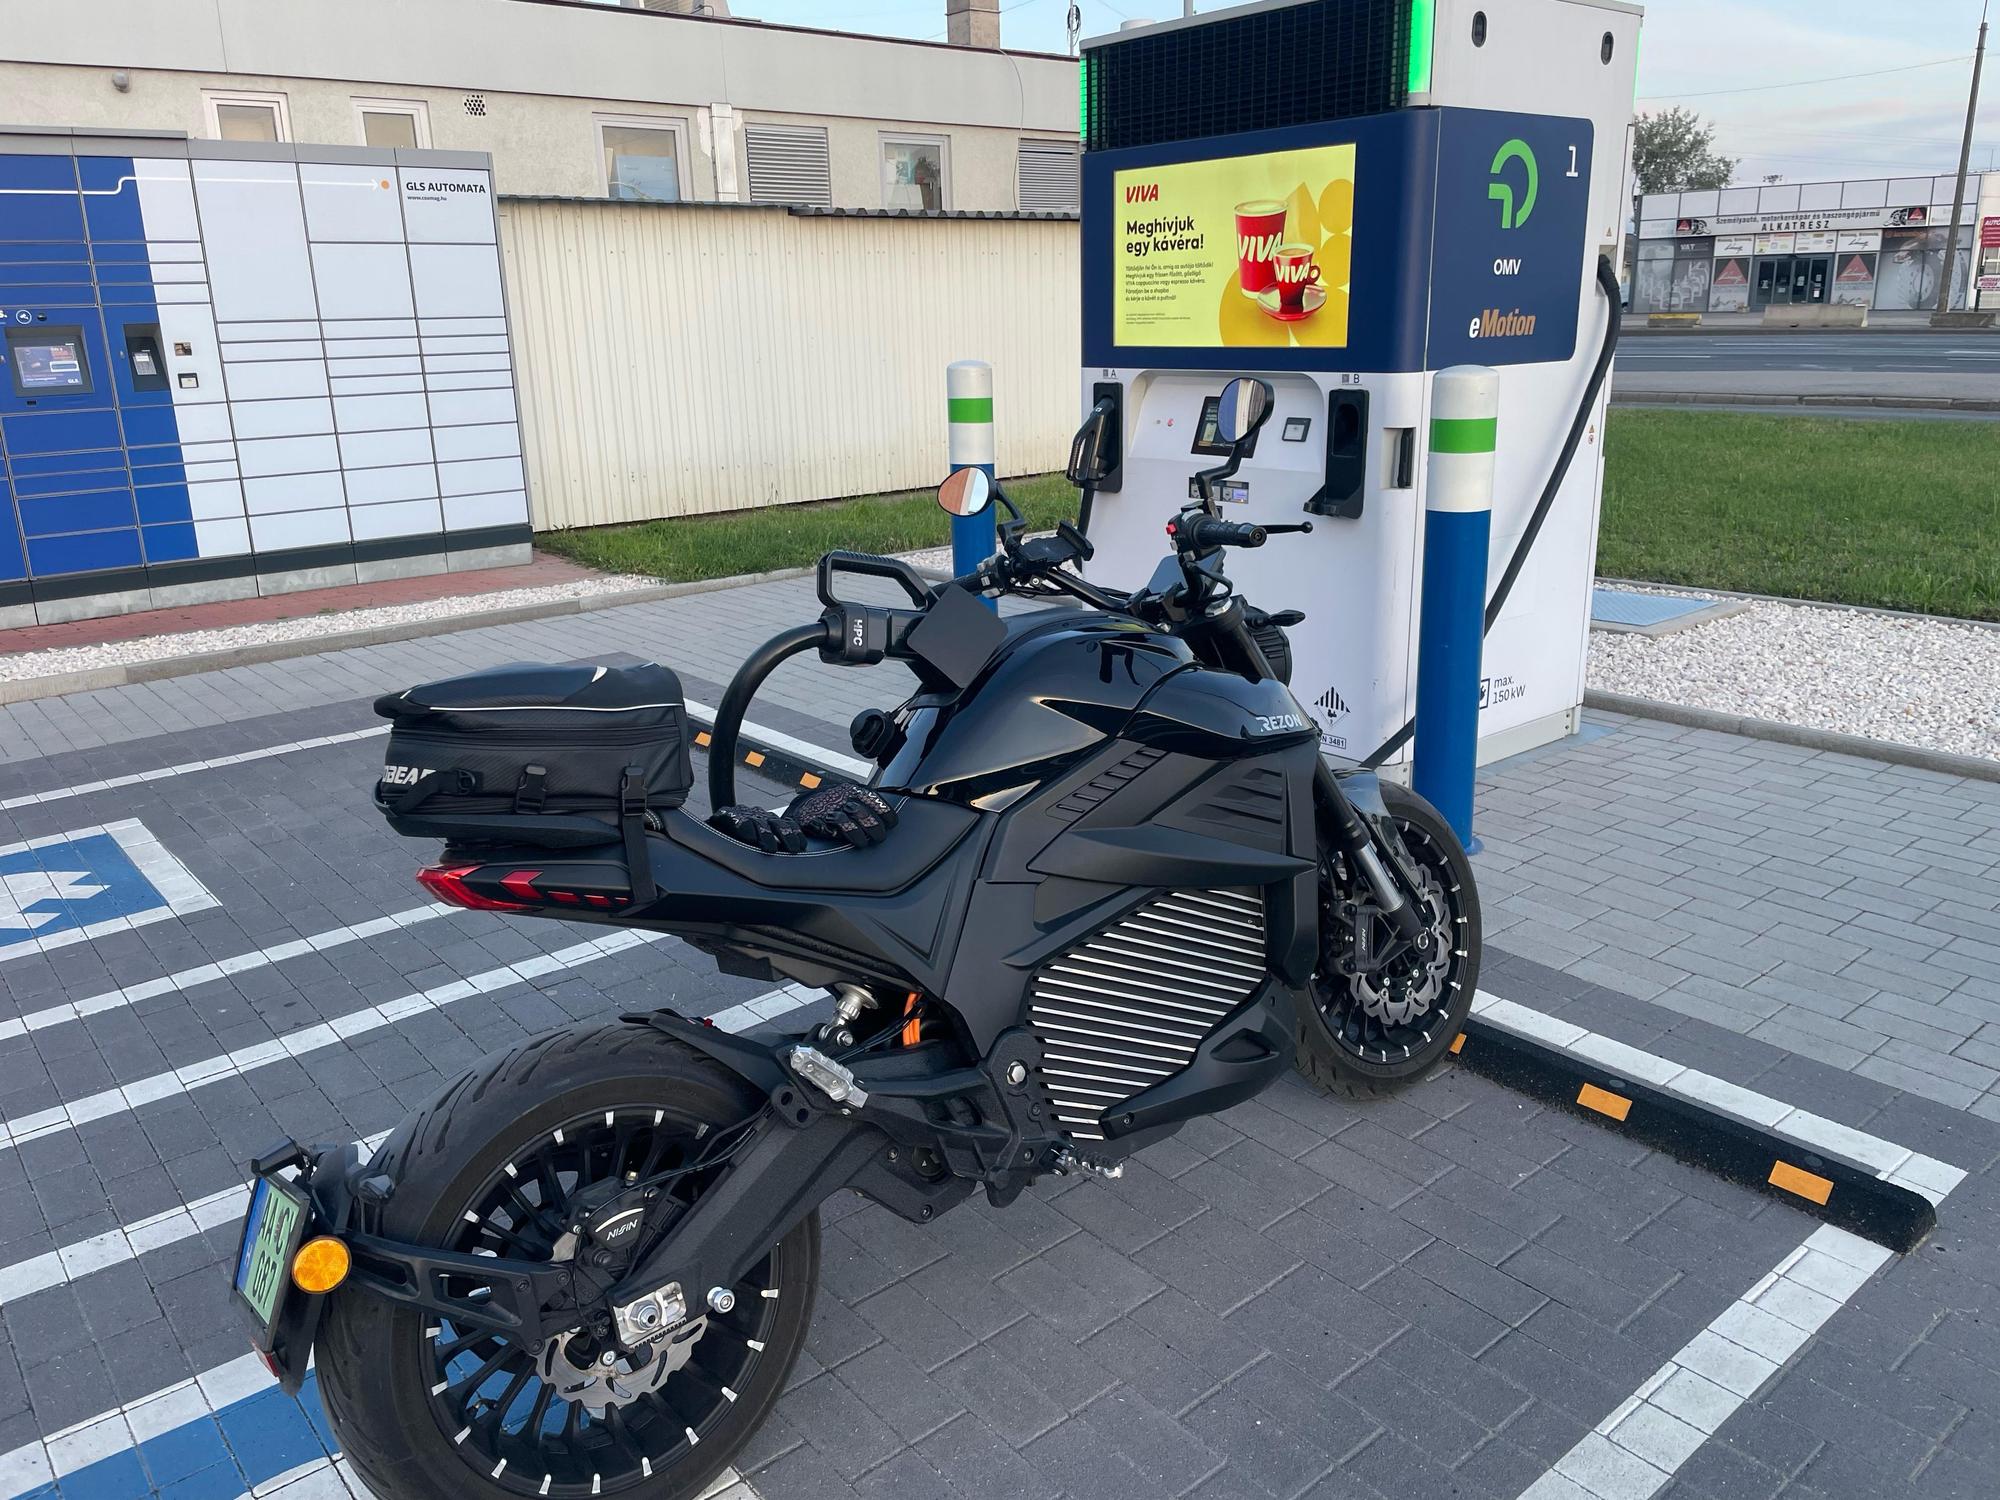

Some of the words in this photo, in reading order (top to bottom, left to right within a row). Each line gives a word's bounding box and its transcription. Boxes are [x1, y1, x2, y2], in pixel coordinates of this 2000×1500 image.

[1565, 145, 1579, 178] 1
[406, 181, 426, 192] GLS
[427, 182, 487, 194] AUTOMATA
[1125, 183, 1159, 204] VIVA
[1126, 215, 1195, 238] Meghívjuk
[1126, 241, 1151, 257] egy
[1153, 233, 1204, 252] kávéra!
[1238, 231, 1283, 263] VIVA
[1275, 262, 1311, 284] VIVA
[1493, 258, 1522, 275] OMV
[1469, 308, 1537, 338] eMotion
[1110, 369, 1117, 378] A
[1353, 374, 1360, 383] B
[853, 619, 863, 647] HPC
[1493, 676, 1515, 689] max.
[1492, 688, 1510, 705] 150
[1510, 684, 1526, 700] kW
[1255, 713, 1303, 733] REZON
